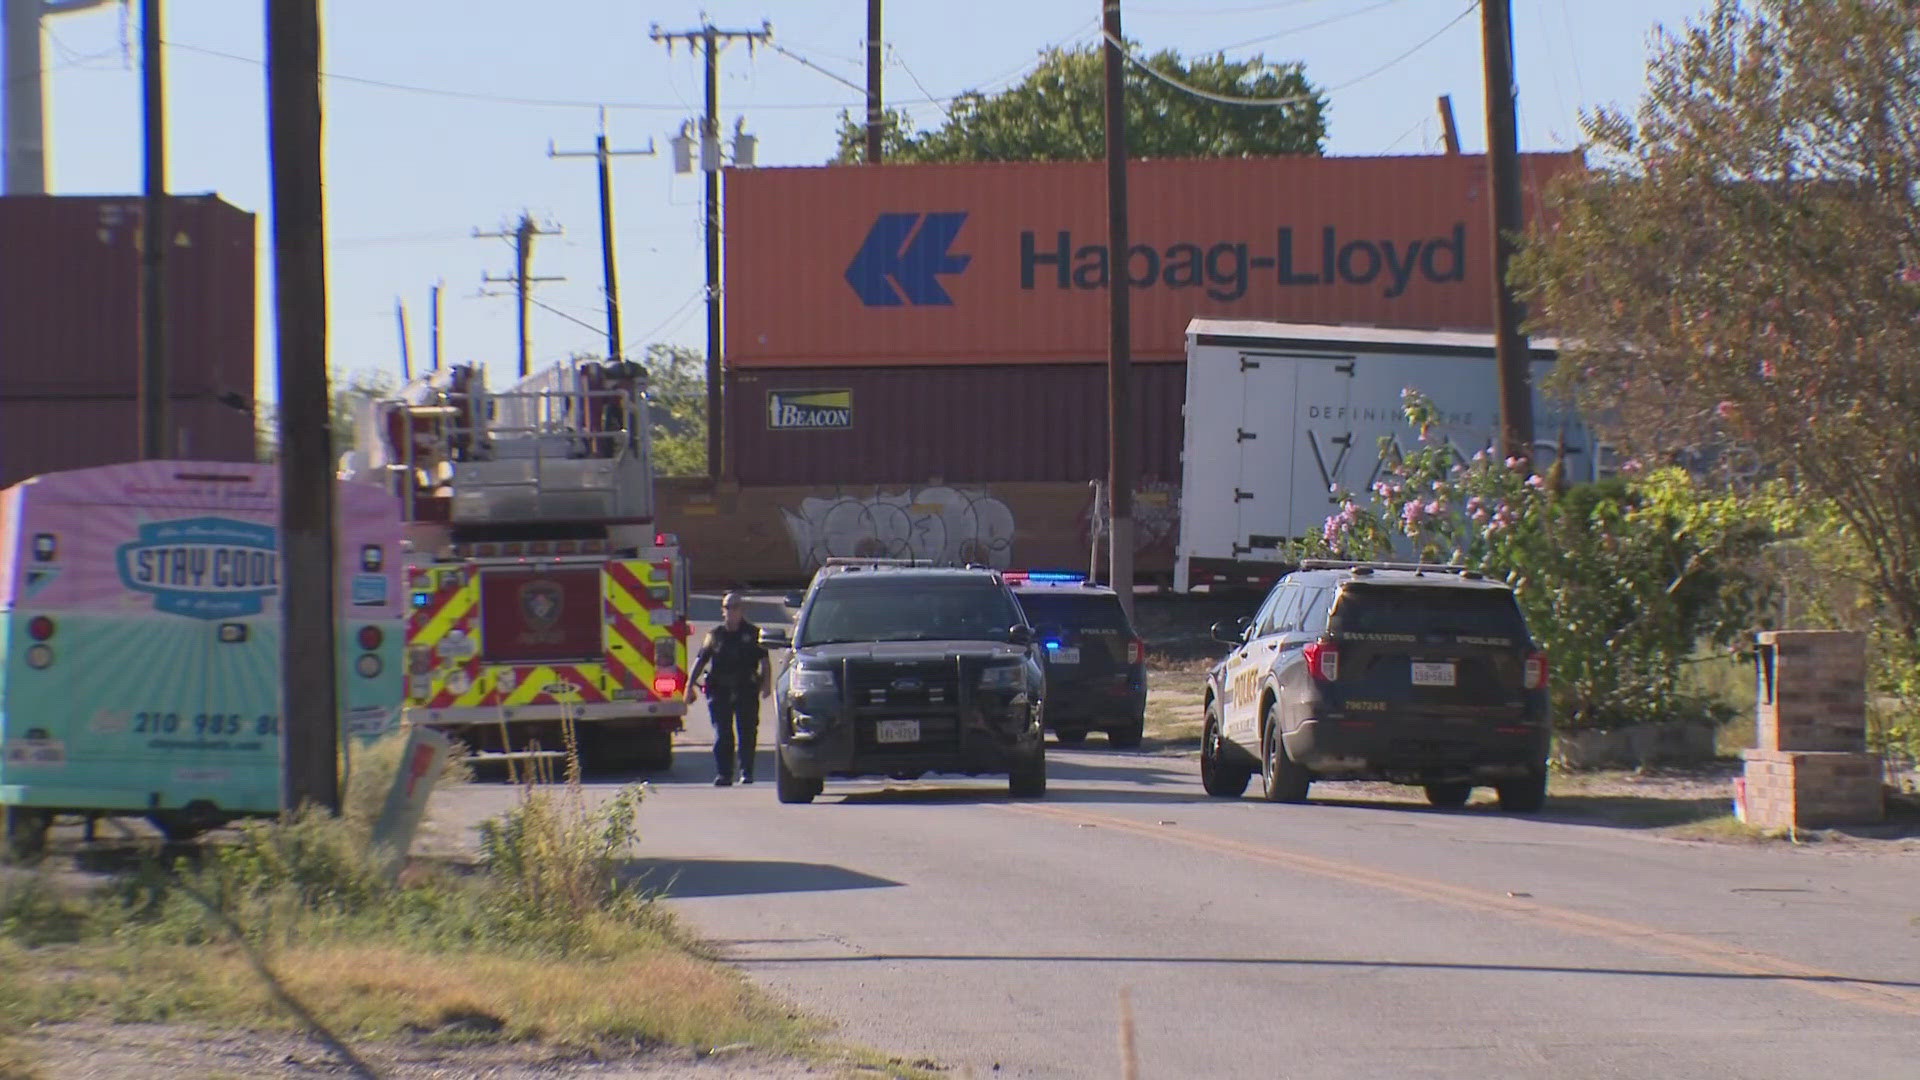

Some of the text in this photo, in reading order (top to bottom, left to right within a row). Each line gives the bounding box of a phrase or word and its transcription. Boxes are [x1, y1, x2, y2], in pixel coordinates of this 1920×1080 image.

[782, 405, 850, 427] BEACON
[1309, 406, 1416, 422] DEFININ
[137, 547, 208, 587] STAY
[1343, 631, 1513, 646] SAN ANTONIO POLICE
[133, 712, 179, 733] 210
[195, 713, 242, 735] 985
